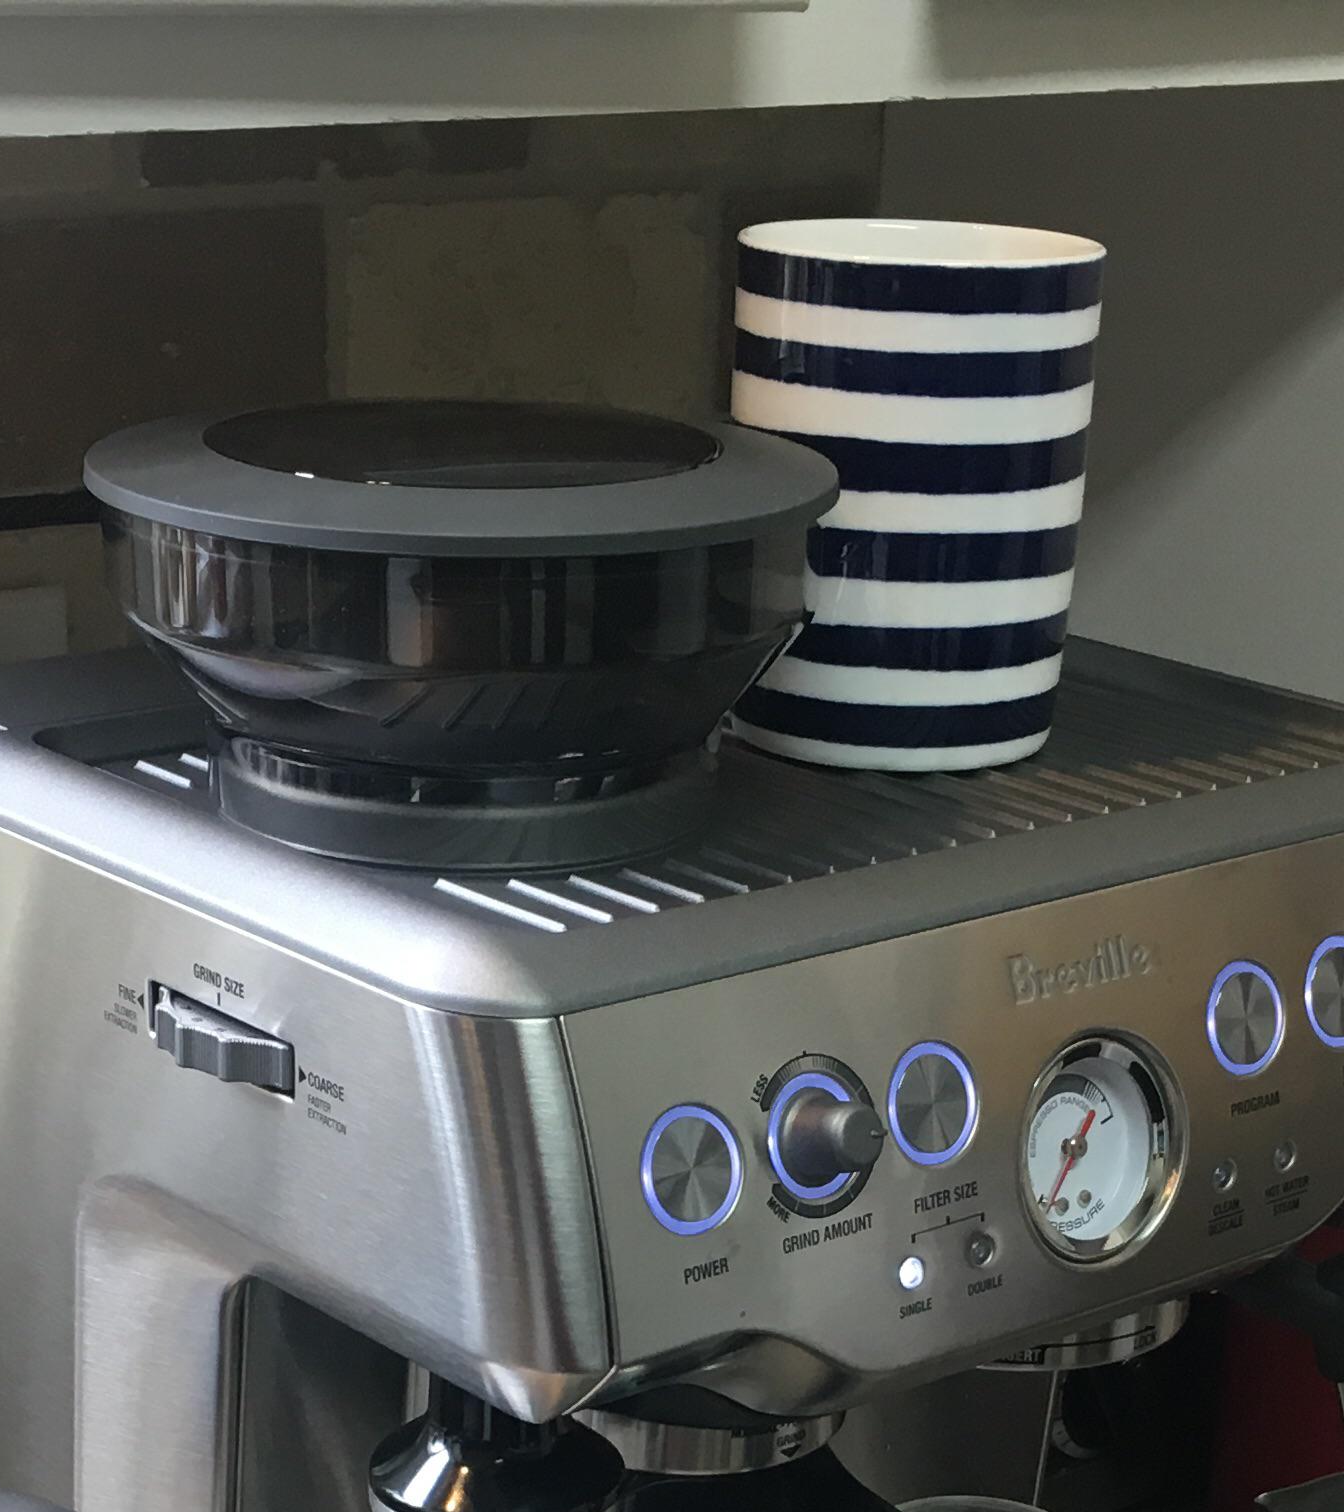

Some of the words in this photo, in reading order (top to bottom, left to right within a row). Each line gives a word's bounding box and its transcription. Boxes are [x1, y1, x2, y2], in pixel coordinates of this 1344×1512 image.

[193, 963, 222, 989] GRIND
[224, 976, 245, 999] SIZE
[1006, 933, 1152, 1006] Breville
[118, 983, 137, 1004] FINE
[307, 1071, 345, 1102] COARSE
[750, 1073, 769, 1103] LESS
[1230, 1090, 1281, 1117] PROGRAM
[766, 1196, 792, 1224] MORE
[913, 1189, 951, 1214] FILTER
[954, 1181, 978, 1203] SIZE
[1049, 1198, 1106, 1234] RESSURE
[782, 1229, 821, 1254] GRIND
[823, 1213, 873, 1243] AMOUNT
[683, 1257, 729, 1285] POWER
[967, 1274, 1004, 1296] DOUBLE
[899, 1297, 932, 1319] SINGLE
